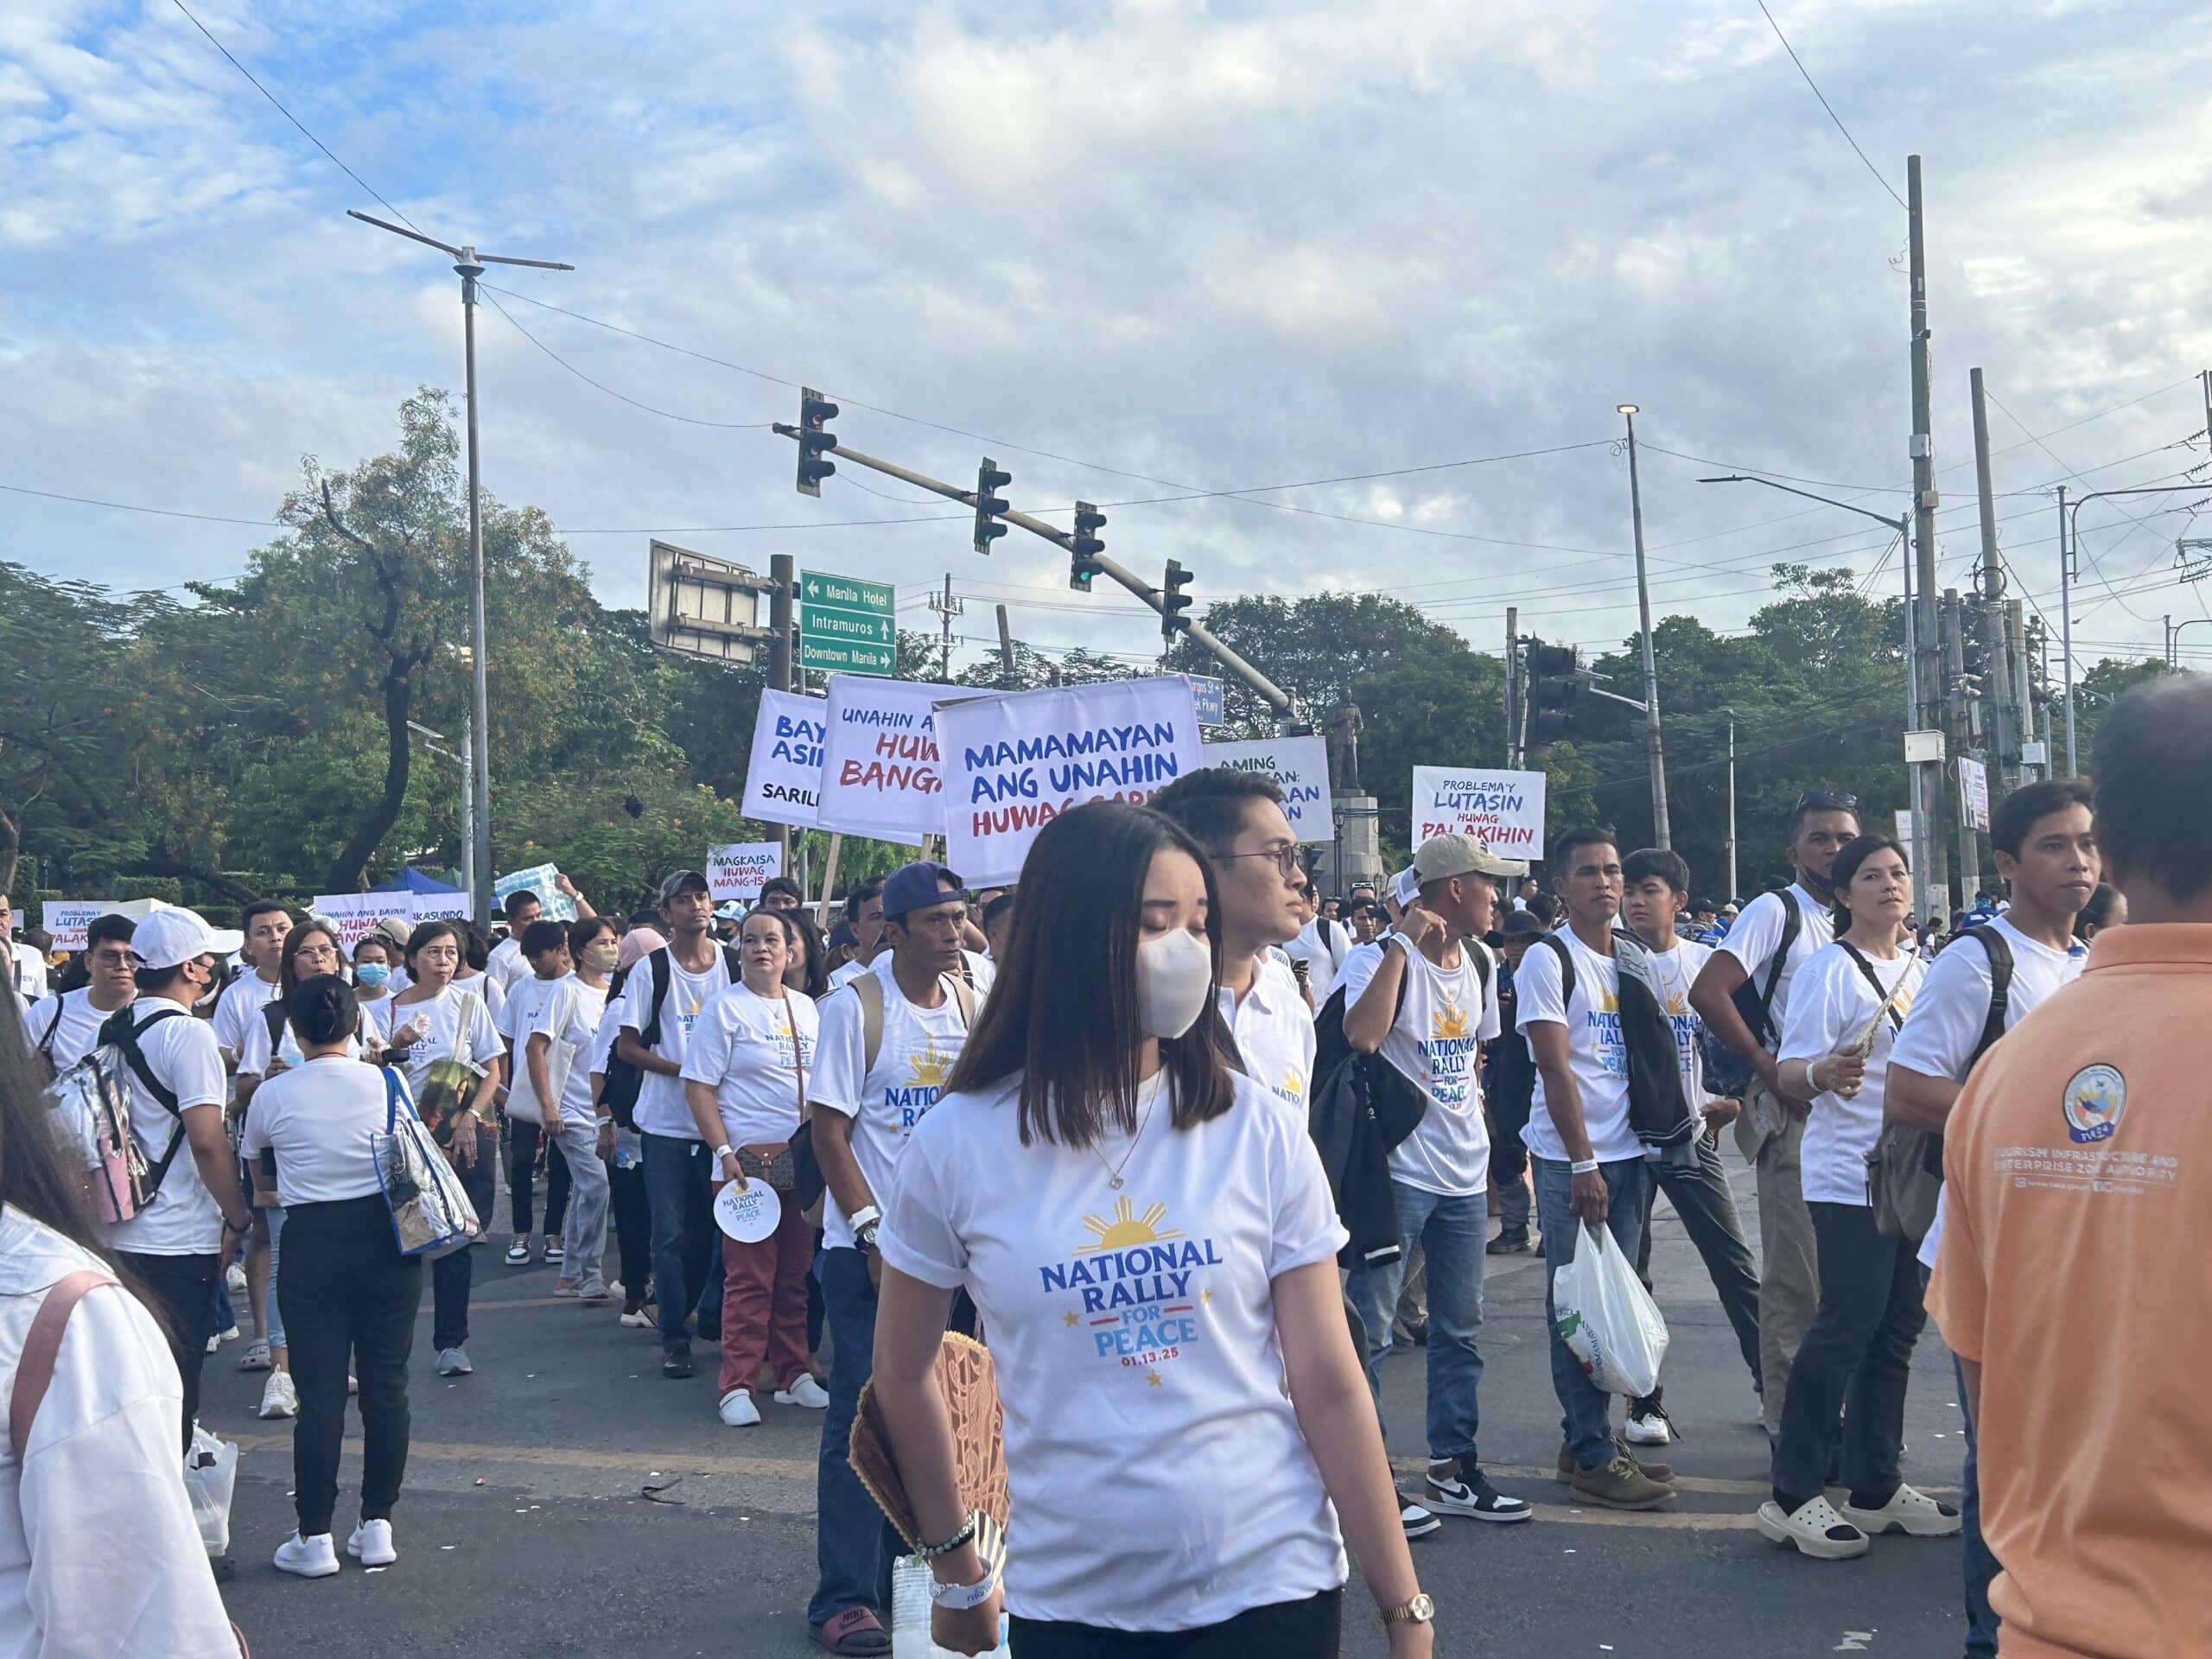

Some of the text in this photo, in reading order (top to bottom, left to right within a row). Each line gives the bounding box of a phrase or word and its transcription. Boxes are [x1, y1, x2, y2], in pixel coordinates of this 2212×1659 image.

[826, 584, 887, 607] Manila Hotel
[812, 614, 874, 635] Intramuros
[804, 645, 877, 665] Downtown Manila
[842, 709, 913, 728] UNAHIN
[775, 715, 827, 744] BAY
[772, 741, 824, 767] ASI
[965, 722, 1175, 772] MAMAMAYAN
[840, 760, 943, 794] BANG
[971, 753, 1178, 804] ANG UNAHIN
[1434, 792, 1523, 812] LUTASIN
[1458, 813, 1499, 824] HUWAG
[713, 855, 775, 867] MAGKAISA
[724, 866, 765, 877] HUWAG
[340, 917, 387, 931] HUWA
[1417, 1037, 1476, 1058] NATIONAL
[1432, 1055, 1466, 1075] RALLY
[1444, 1076, 1458, 1085] FOR
[885, 1085, 941, 1107] NATIO
[1432, 1085, 1467, 1103] PEAC
[722, 1190, 765, 1207] NATIONAL
[732, 1198, 758, 1211] RALLY
[1039, 1238, 1224, 1293] NATIONAL
[1082, 1270, 1192, 1314] RALLY
[1122, 1305, 1160, 1325] FOR
[1093, 1318, 1198, 1357] PEACE
[1121, 1346, 1179, 1367] 01.13.25
